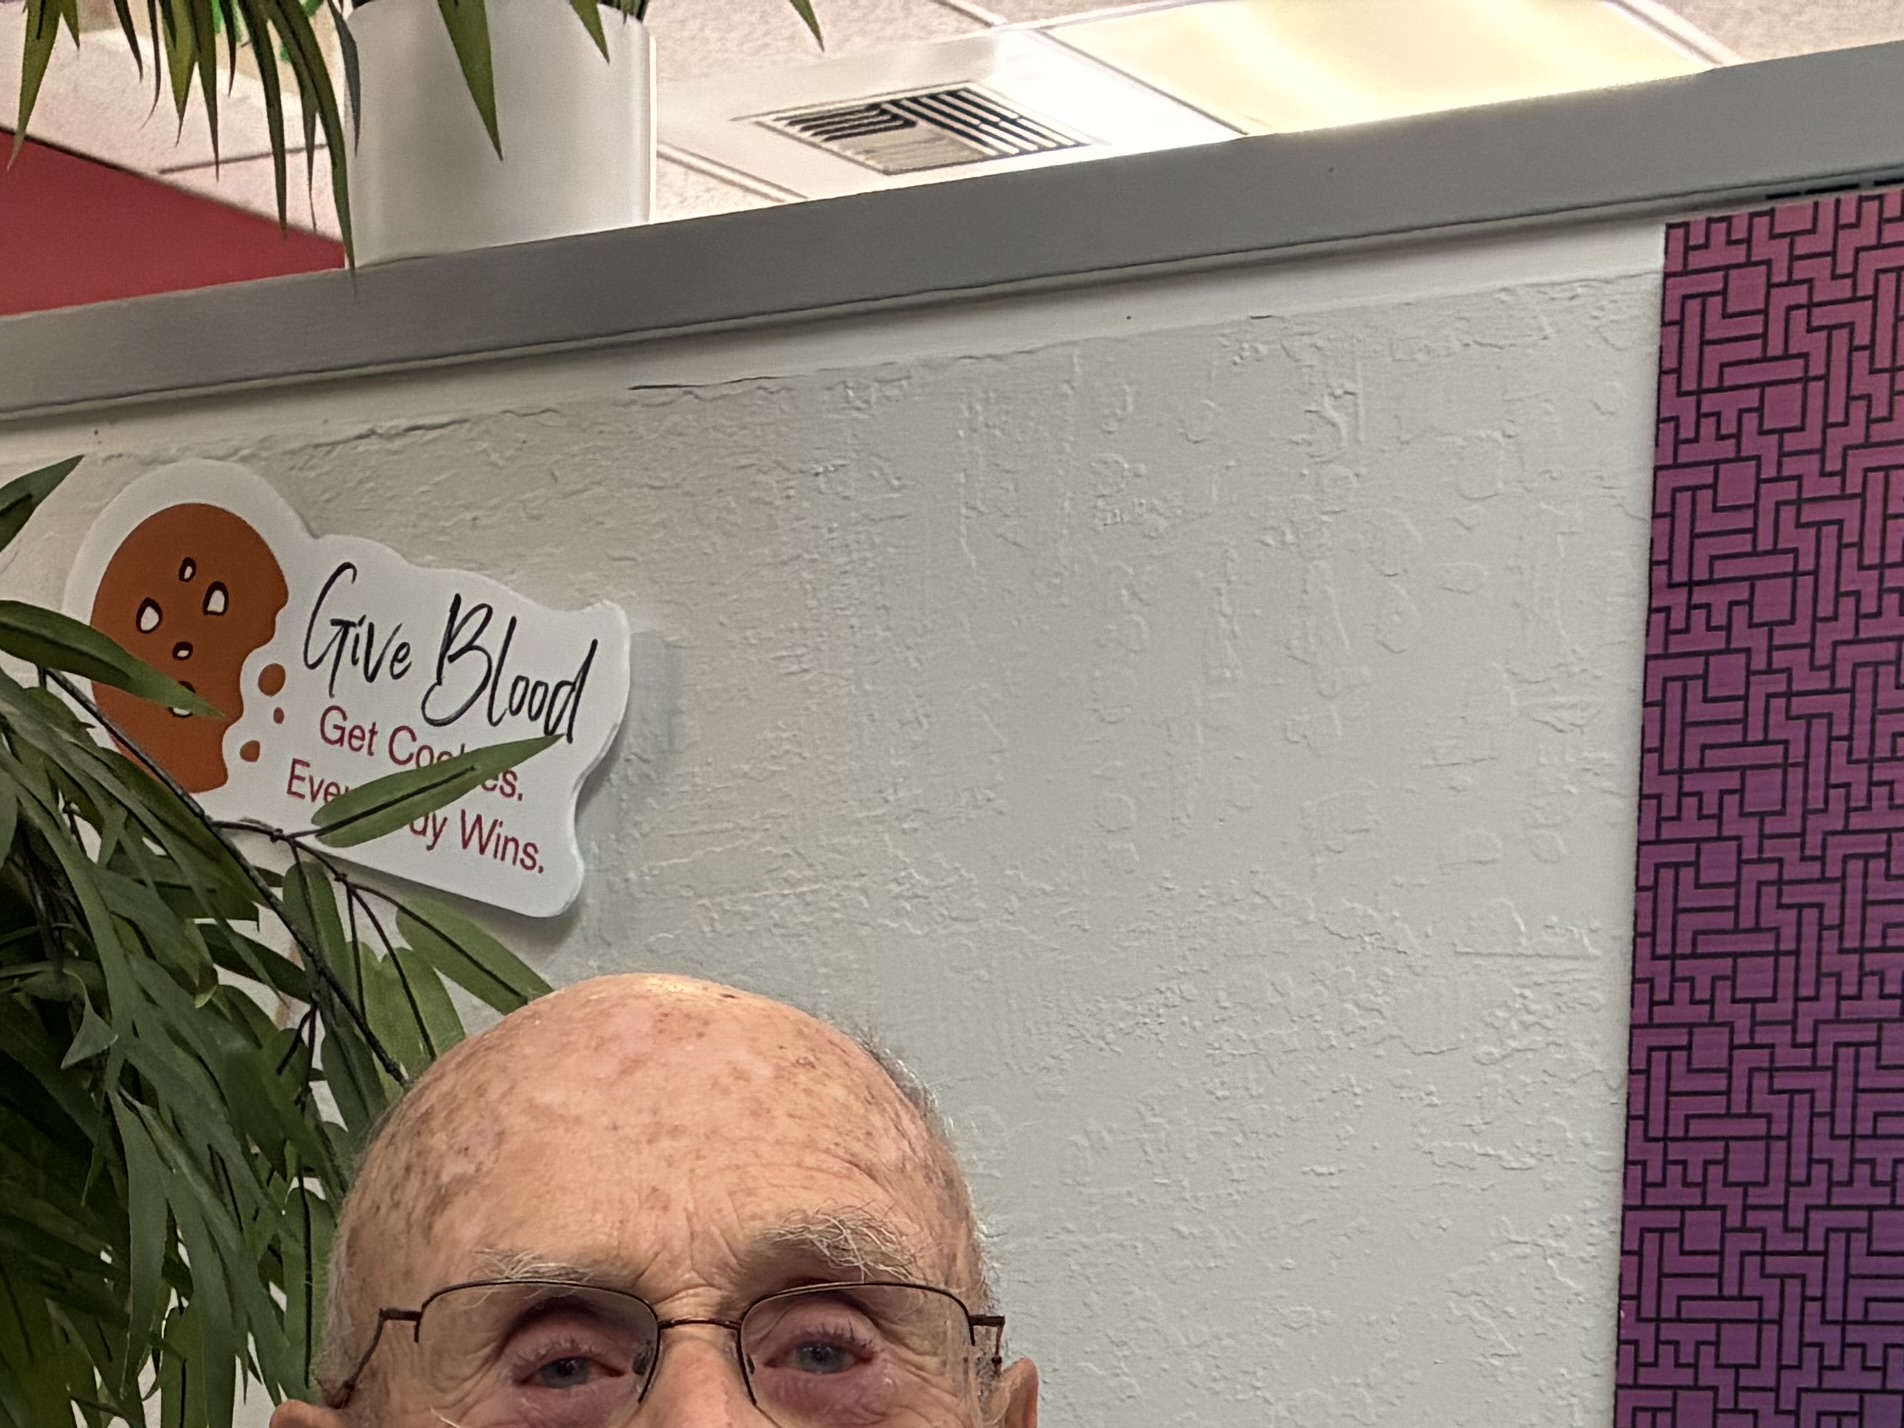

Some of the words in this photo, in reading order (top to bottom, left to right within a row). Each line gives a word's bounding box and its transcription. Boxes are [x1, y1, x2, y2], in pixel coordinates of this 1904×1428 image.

[302, 563, 413, 697] Give
[421, 595, 598, 743] Blood
[319, 705, 378, 757] Get
[388, 725, 524, 801] Coes.
[460, 809, 545, 874] Wins.
